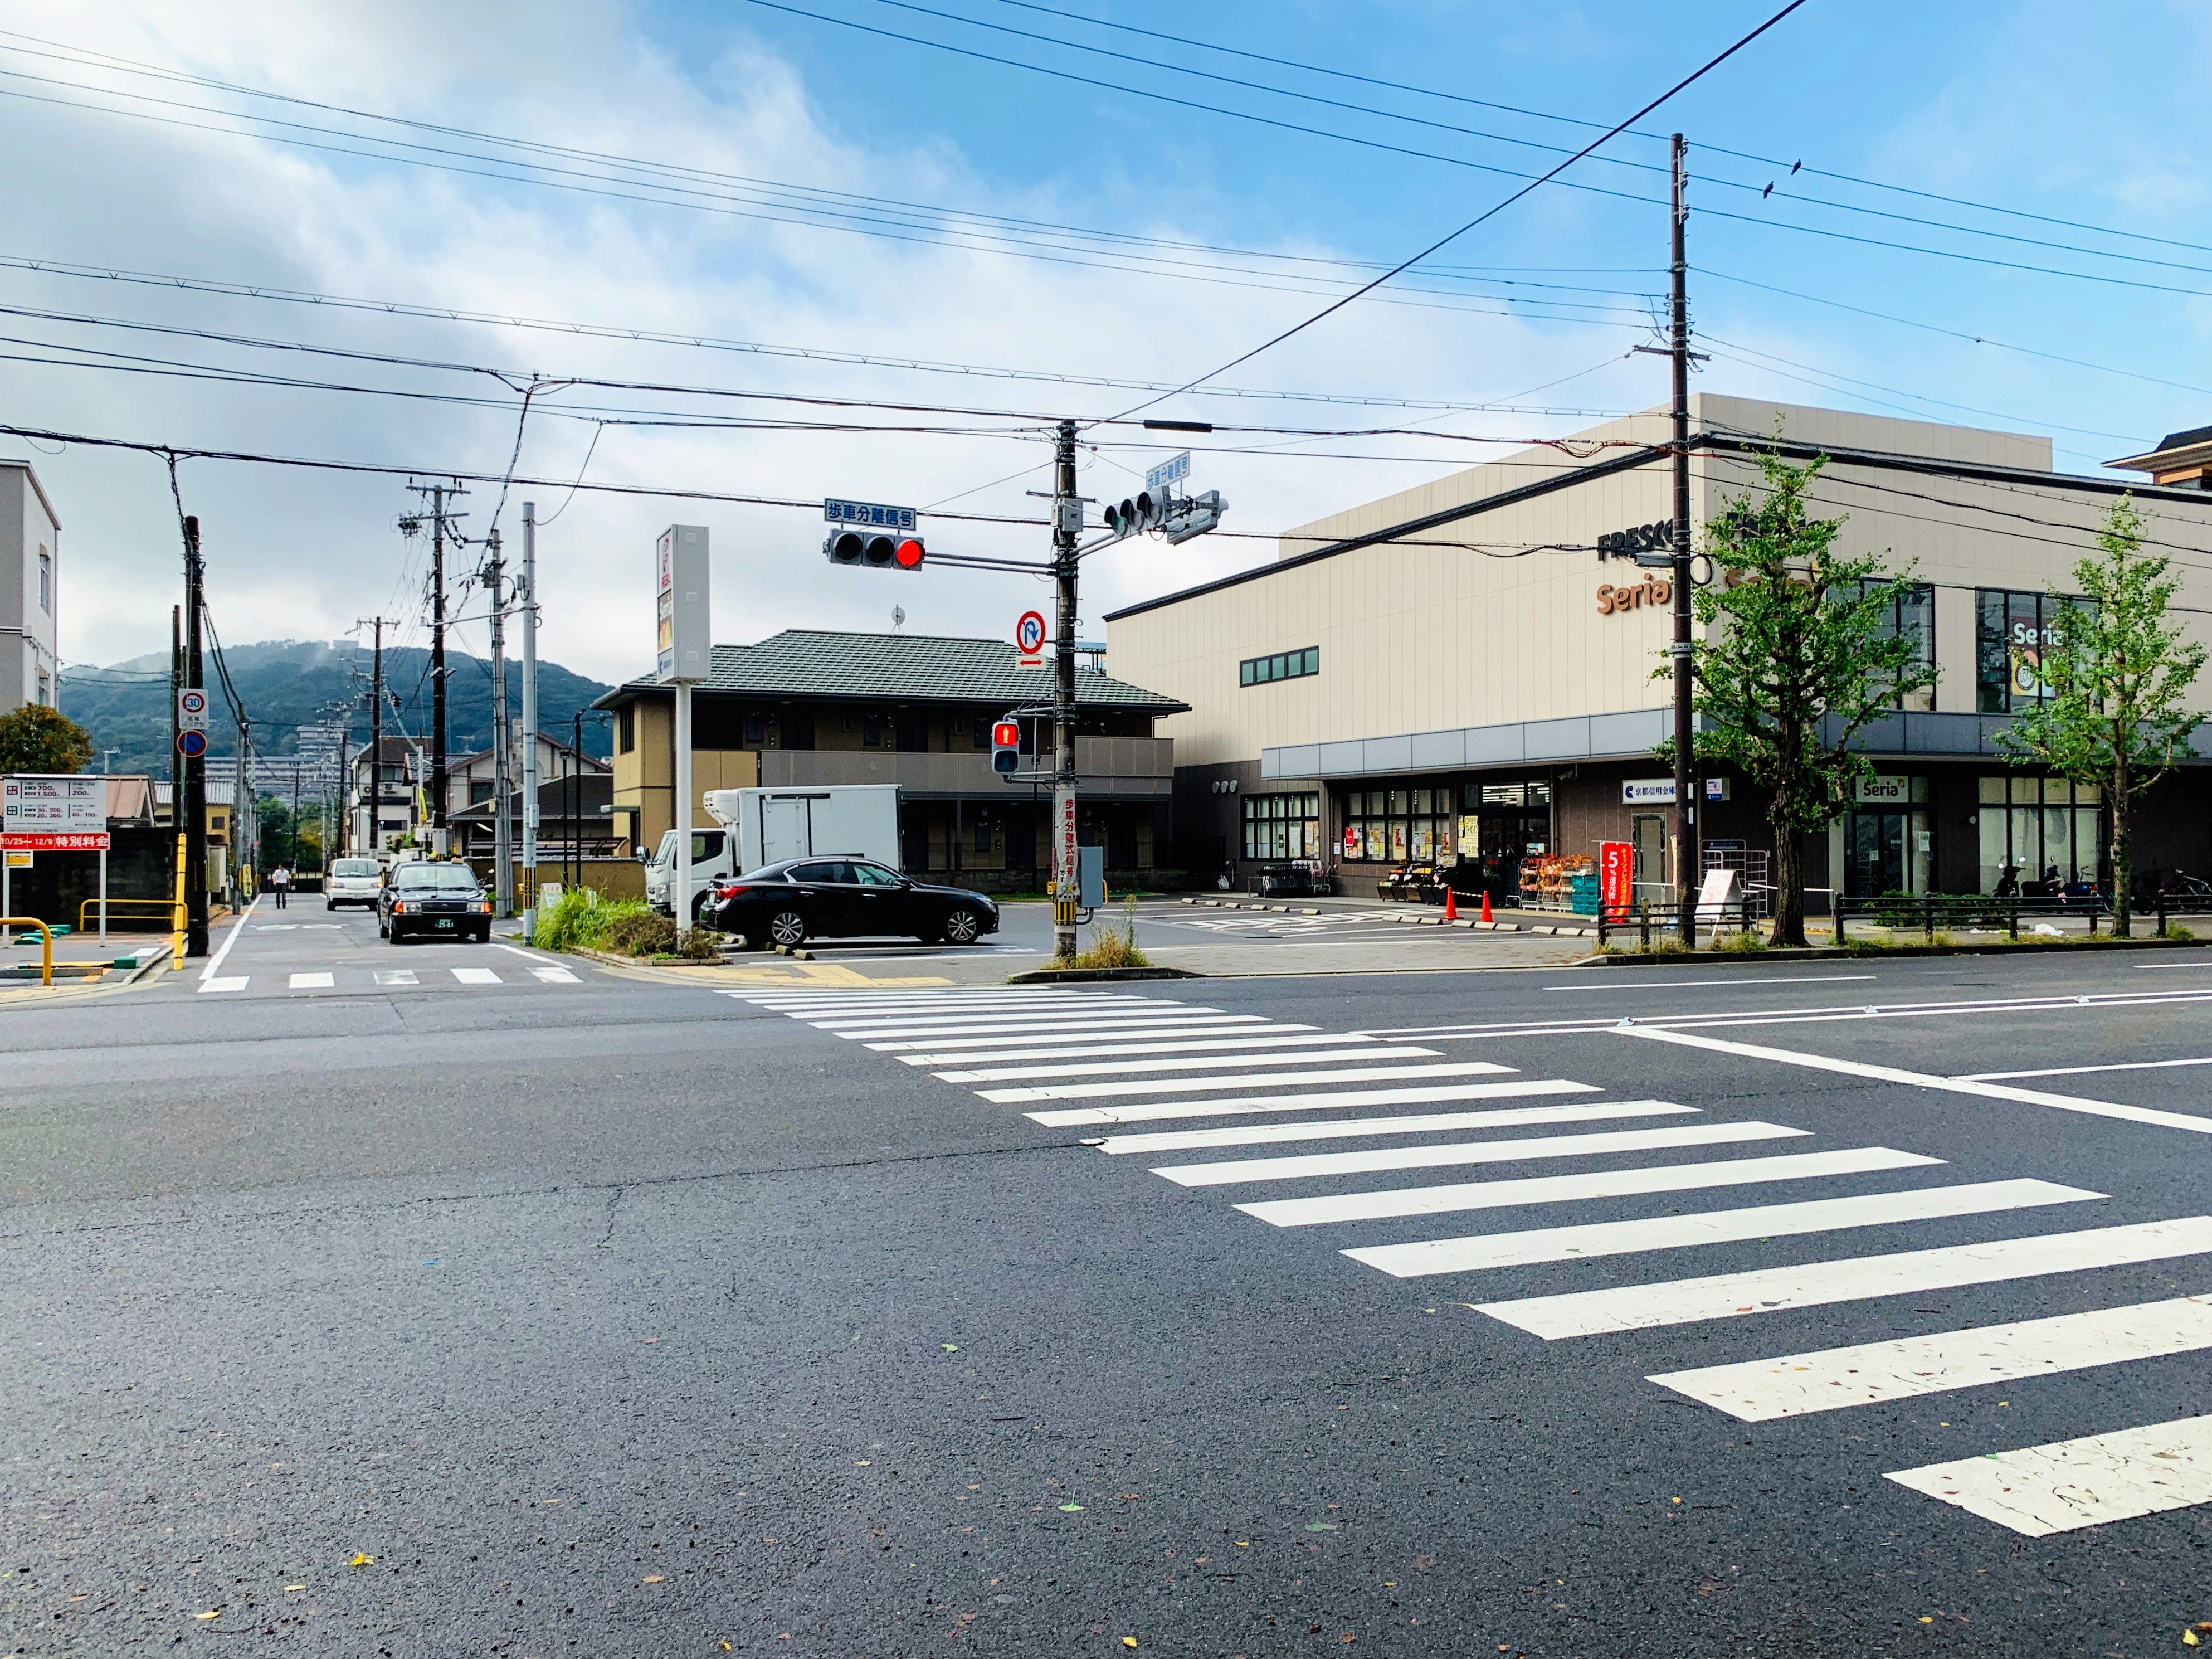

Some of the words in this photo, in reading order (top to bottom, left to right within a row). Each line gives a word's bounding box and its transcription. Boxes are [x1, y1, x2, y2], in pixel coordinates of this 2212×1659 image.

[1148, 456, 1188, 490] 歩車分離信号
[828, 503, 912, 527] 歩車分離信号
[1597, 573, 1669, 614] Seria
[187, 698, 200, 707] 30
[1635, 786, 1676, 796] 京都信用金庫
[1863, 781, 1898, 797] Seria
[1465, 825, 1478, 834] 9:00
[56, 835, 109, 848] 特別料金
[1065, 799, 1075, 877] 歩車分離式信号
